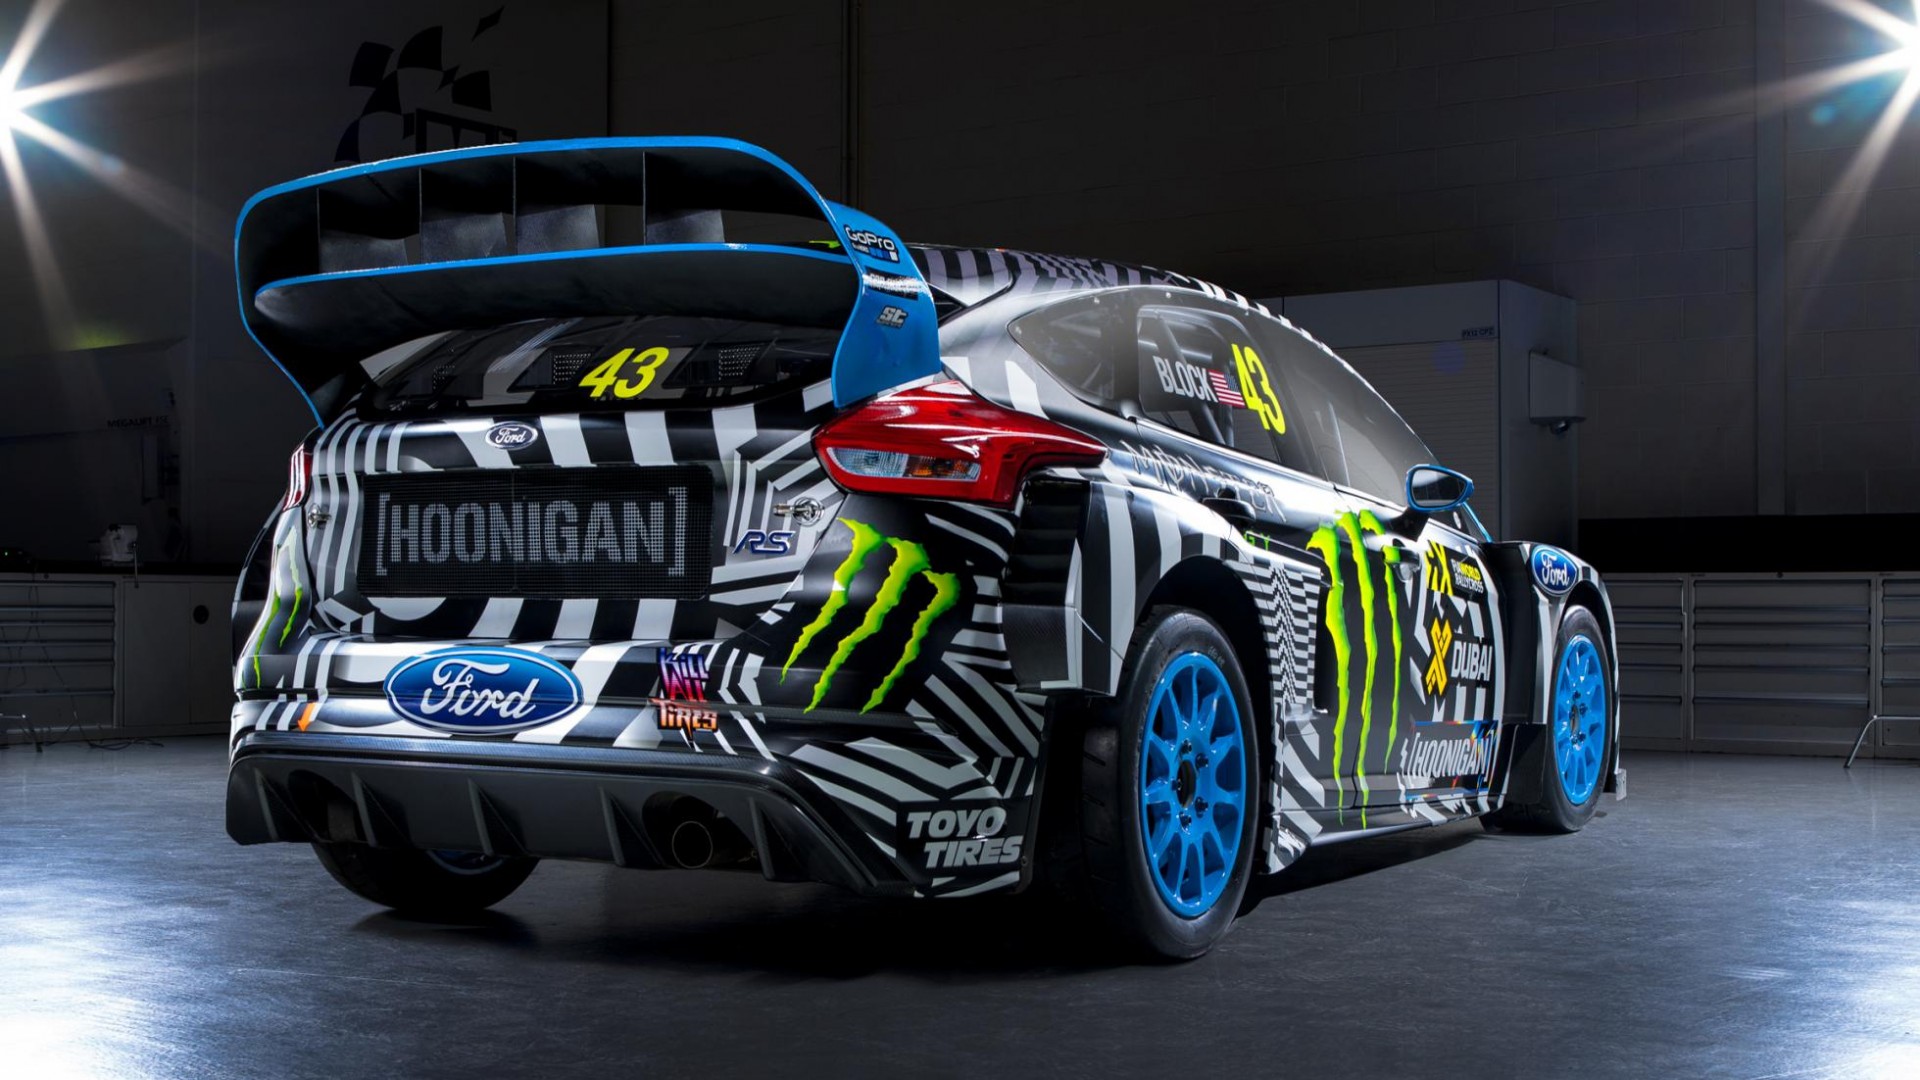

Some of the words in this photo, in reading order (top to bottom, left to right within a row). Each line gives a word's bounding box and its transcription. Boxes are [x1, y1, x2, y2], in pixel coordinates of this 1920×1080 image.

[845, 226, 896, 251] GoPro
[578, 346, 670, 398] 43
[1153, 355, 1219, 403] BLOCK
[1231, 343, 1286, 435] 43
[495, 427, 527, 444] Ford
[733, 530, 796, 554] RS
[1541, 552, 1570, 586] Ford
[1451, 640, 1493, 682] DUBAI
[420, 659, 540, 719] Ford
[907, 806, 1007, 838] TOYO
[924, 836, 1024, 869] TIRES
